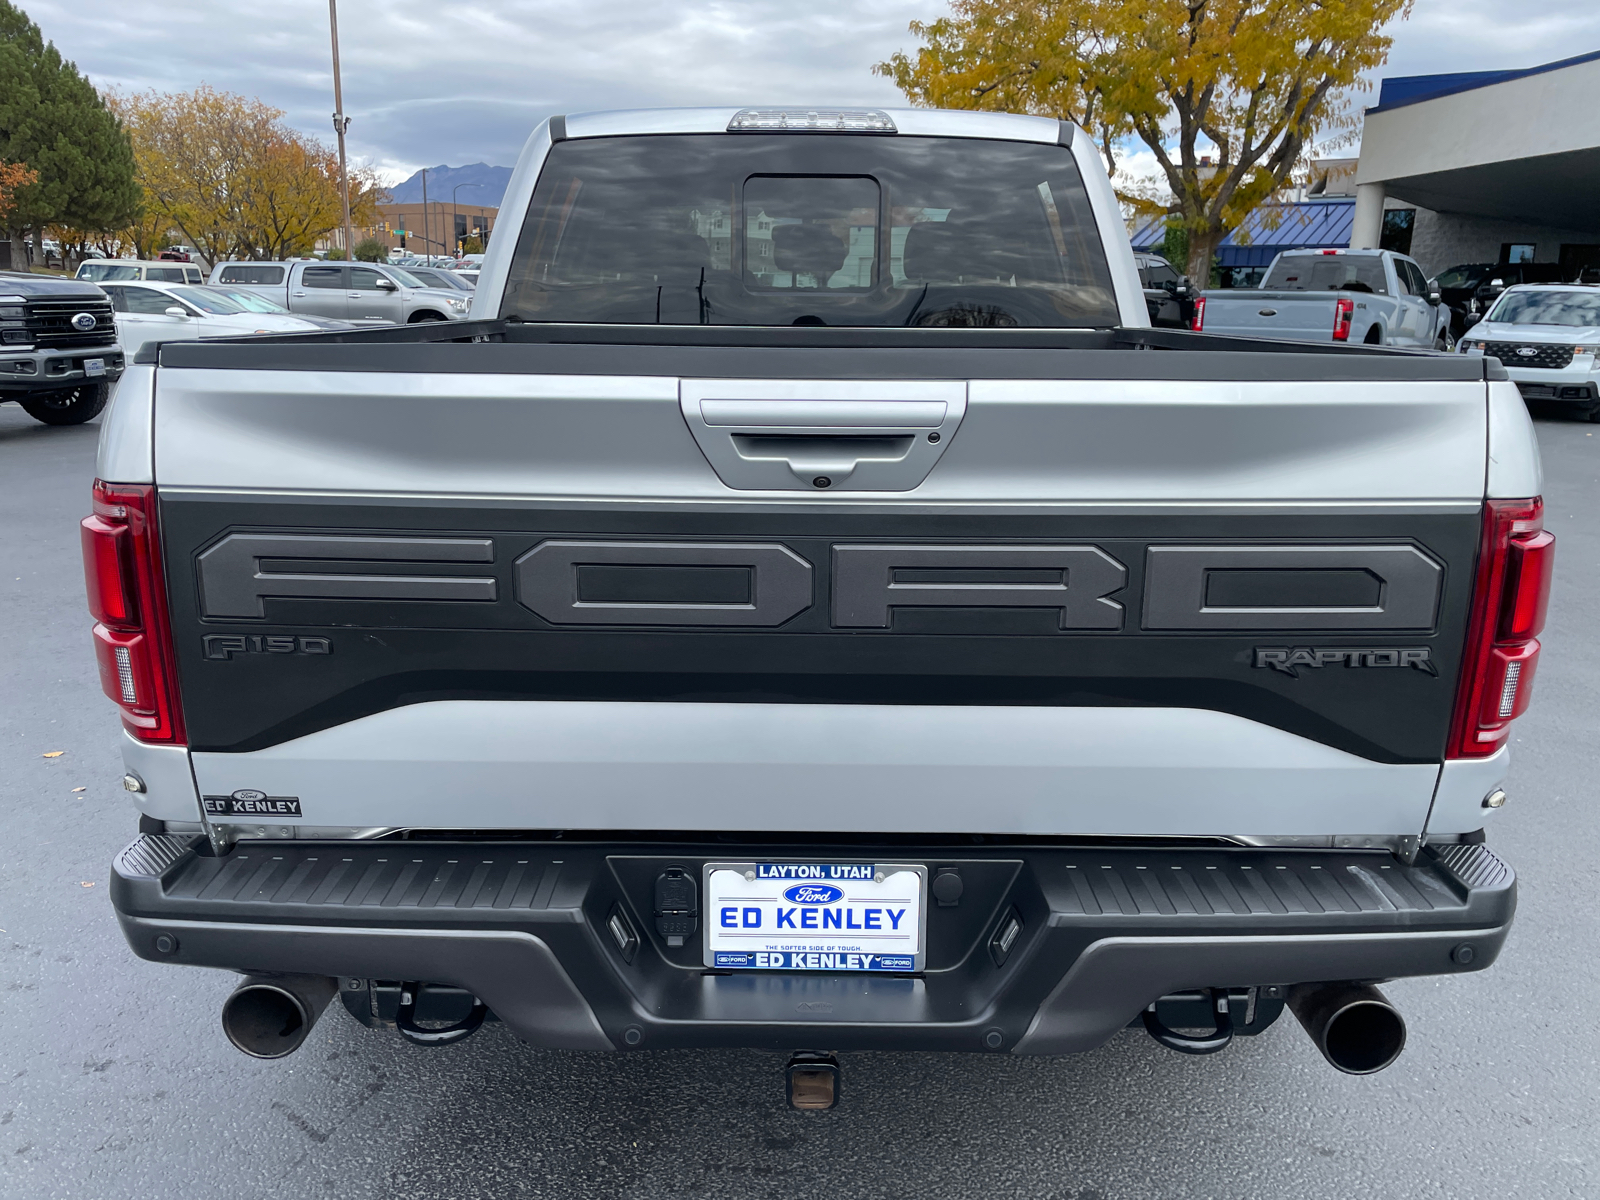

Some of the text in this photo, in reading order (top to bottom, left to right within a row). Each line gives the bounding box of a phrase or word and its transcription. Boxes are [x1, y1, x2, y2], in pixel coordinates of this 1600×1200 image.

[198, 531, 1445, 631] FORD
[1252, 645, 1439, 678] RAPTOR
[205, 800, 298, 813] ED KENLEY
[759, 864, 872, 879] LAYTON, UTAH
[795, 886, 831, 903] Ford
[720, 907, 907, 930] ED KENLEY
[730, 956, 747, 964] FORD
[755, 952, 874, 969] ED KENLEY
[894, 959, 911, 967] FORD
